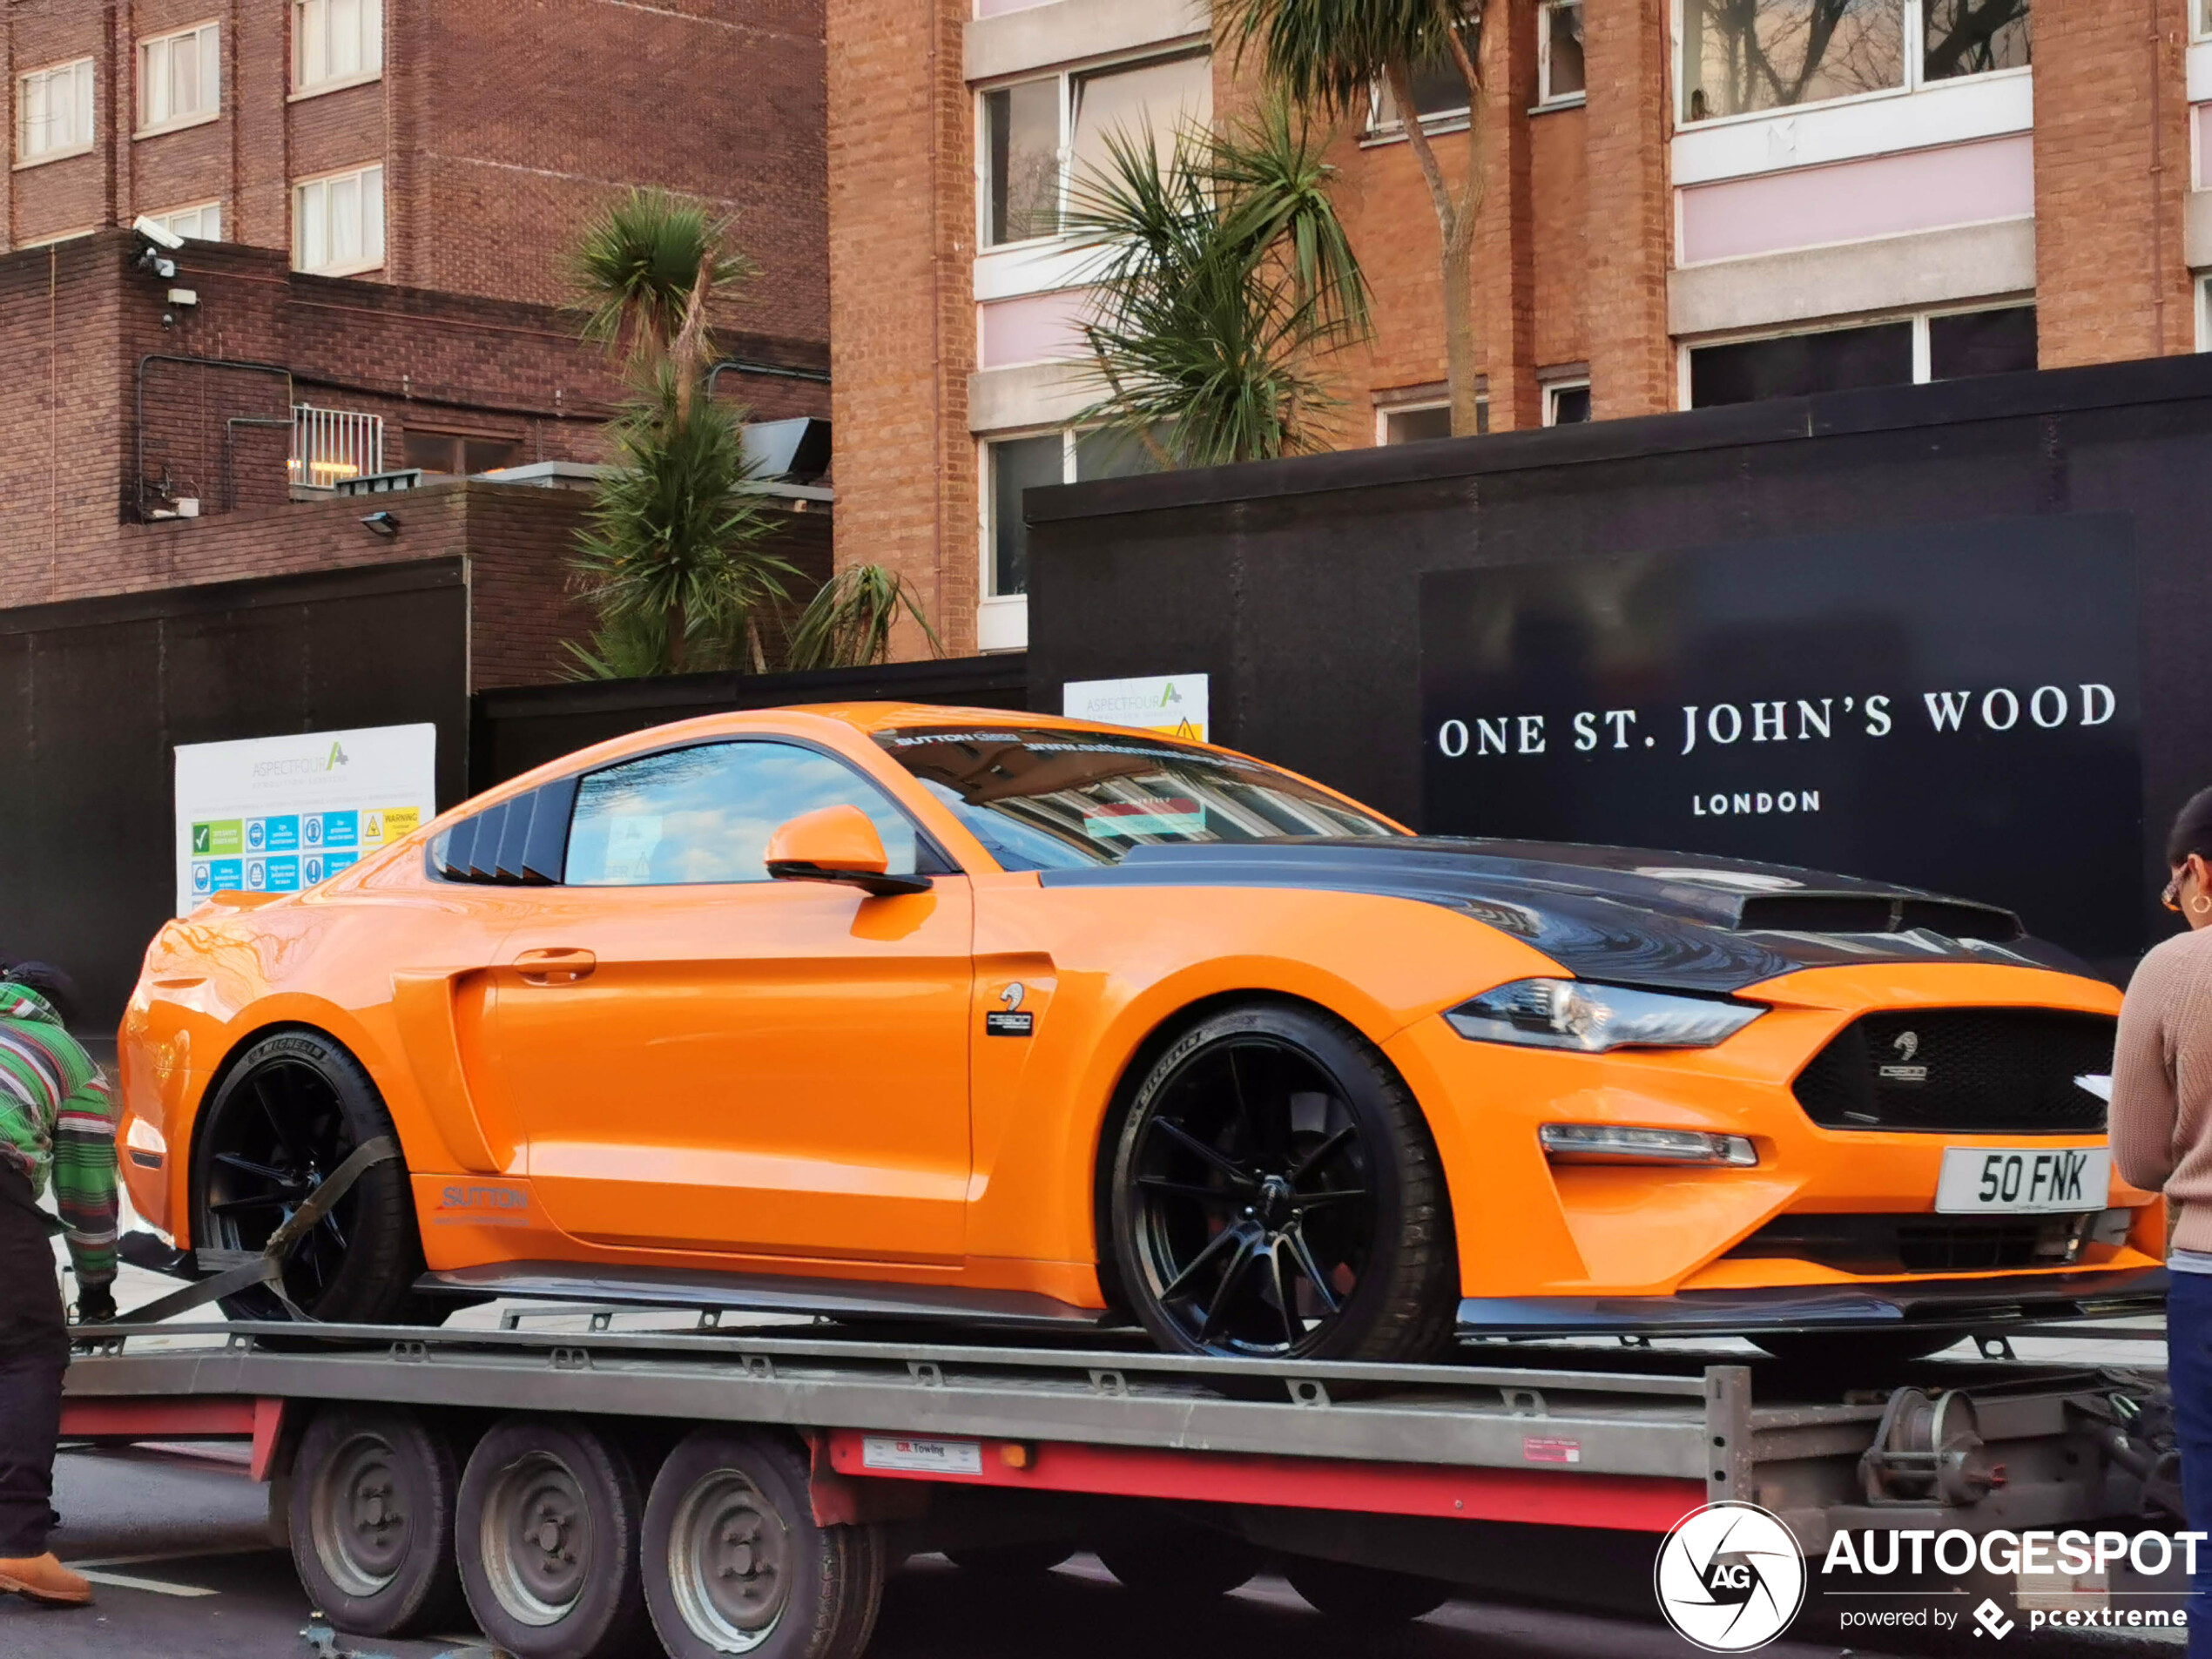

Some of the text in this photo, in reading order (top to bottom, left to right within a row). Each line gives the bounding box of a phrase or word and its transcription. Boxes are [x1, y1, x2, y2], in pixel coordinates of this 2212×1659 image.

[1086, 695, 1161, 711] ASPECTFOUR
[1439, 684, 2115, 757] ONE ST. JOHN'S WOOD
[895, 733, 975, 745] SUTTON
[253, 757, 327, 778] ASPECTFOUR
[1694, 790, 1820, 816] LONDON
[384, 813, 418, 823] WARNING
[263, 1038, 322, 1056] MICHELIN
[1979, 1154, 2087, 1202] 50 FNK
[442, 1186, 528, 1209] SUTTON
[913, 1443, 944, 1457] Towing
